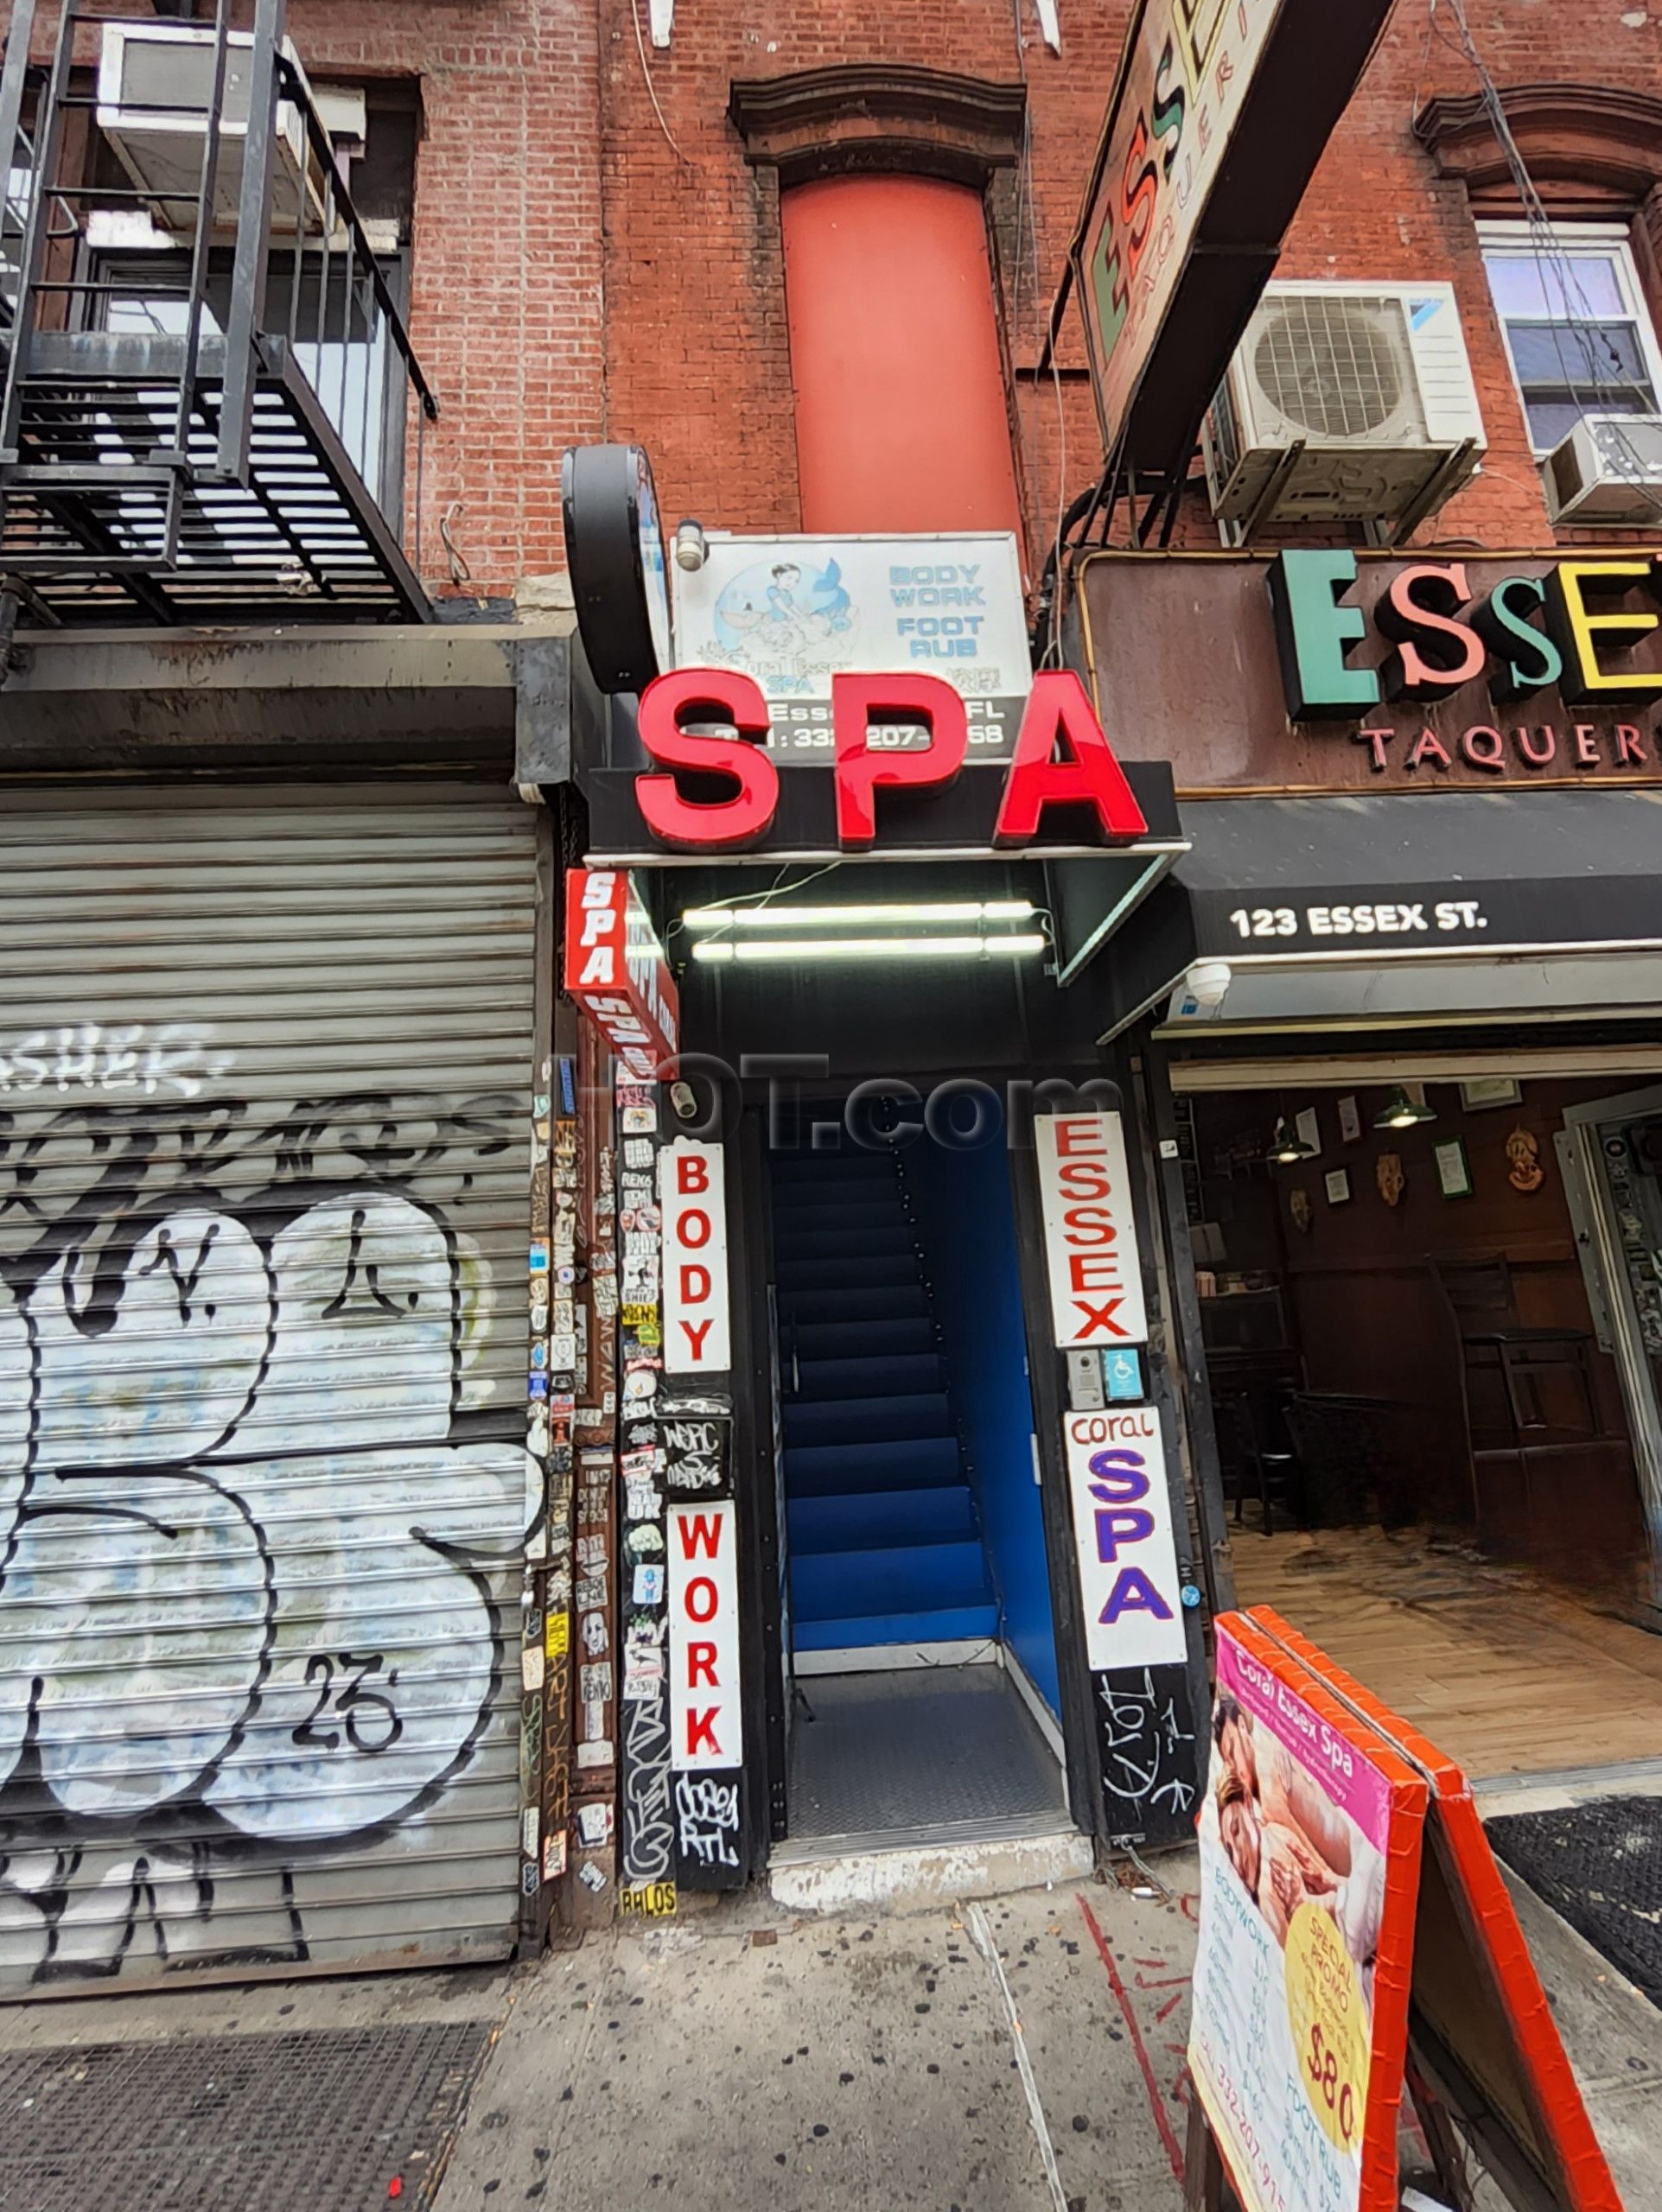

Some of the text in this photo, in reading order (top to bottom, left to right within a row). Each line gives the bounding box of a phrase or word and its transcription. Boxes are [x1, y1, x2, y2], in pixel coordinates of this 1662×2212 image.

[1092, 0, 1231, 369] ESSE
[889, 564, 981, 586] BODY
[889, 587, 987, 607] WORK
[896, 615, 984, 637] FOOT
[1279, 549, 1662, 704] ESSE
[766, 675, 815, 694] SPA
[909, 638, 977, 658] RUB
[635, 668, 1149, 850] SPA
[1359, 722, 1662, 770] TAQUER
[578, 871, 616, 984] SPA
[1229, 900, 1488, 938] 123 ESSEX ST.
[676, 1154, 715, 1362] BODY
[1054, 1118, 1134, 1340] ESSEX
[1088, 1448, 1175, 1624] SPA
[678, 1513, 724, 1757] WORK
[1235, 1649, 1276, 1701] Coral
[1277, 1688, 1319, 1744] Essex
[1321, 1725, 1353, 1777] Spa
[1307, 2022, 1355, 2141] $80
